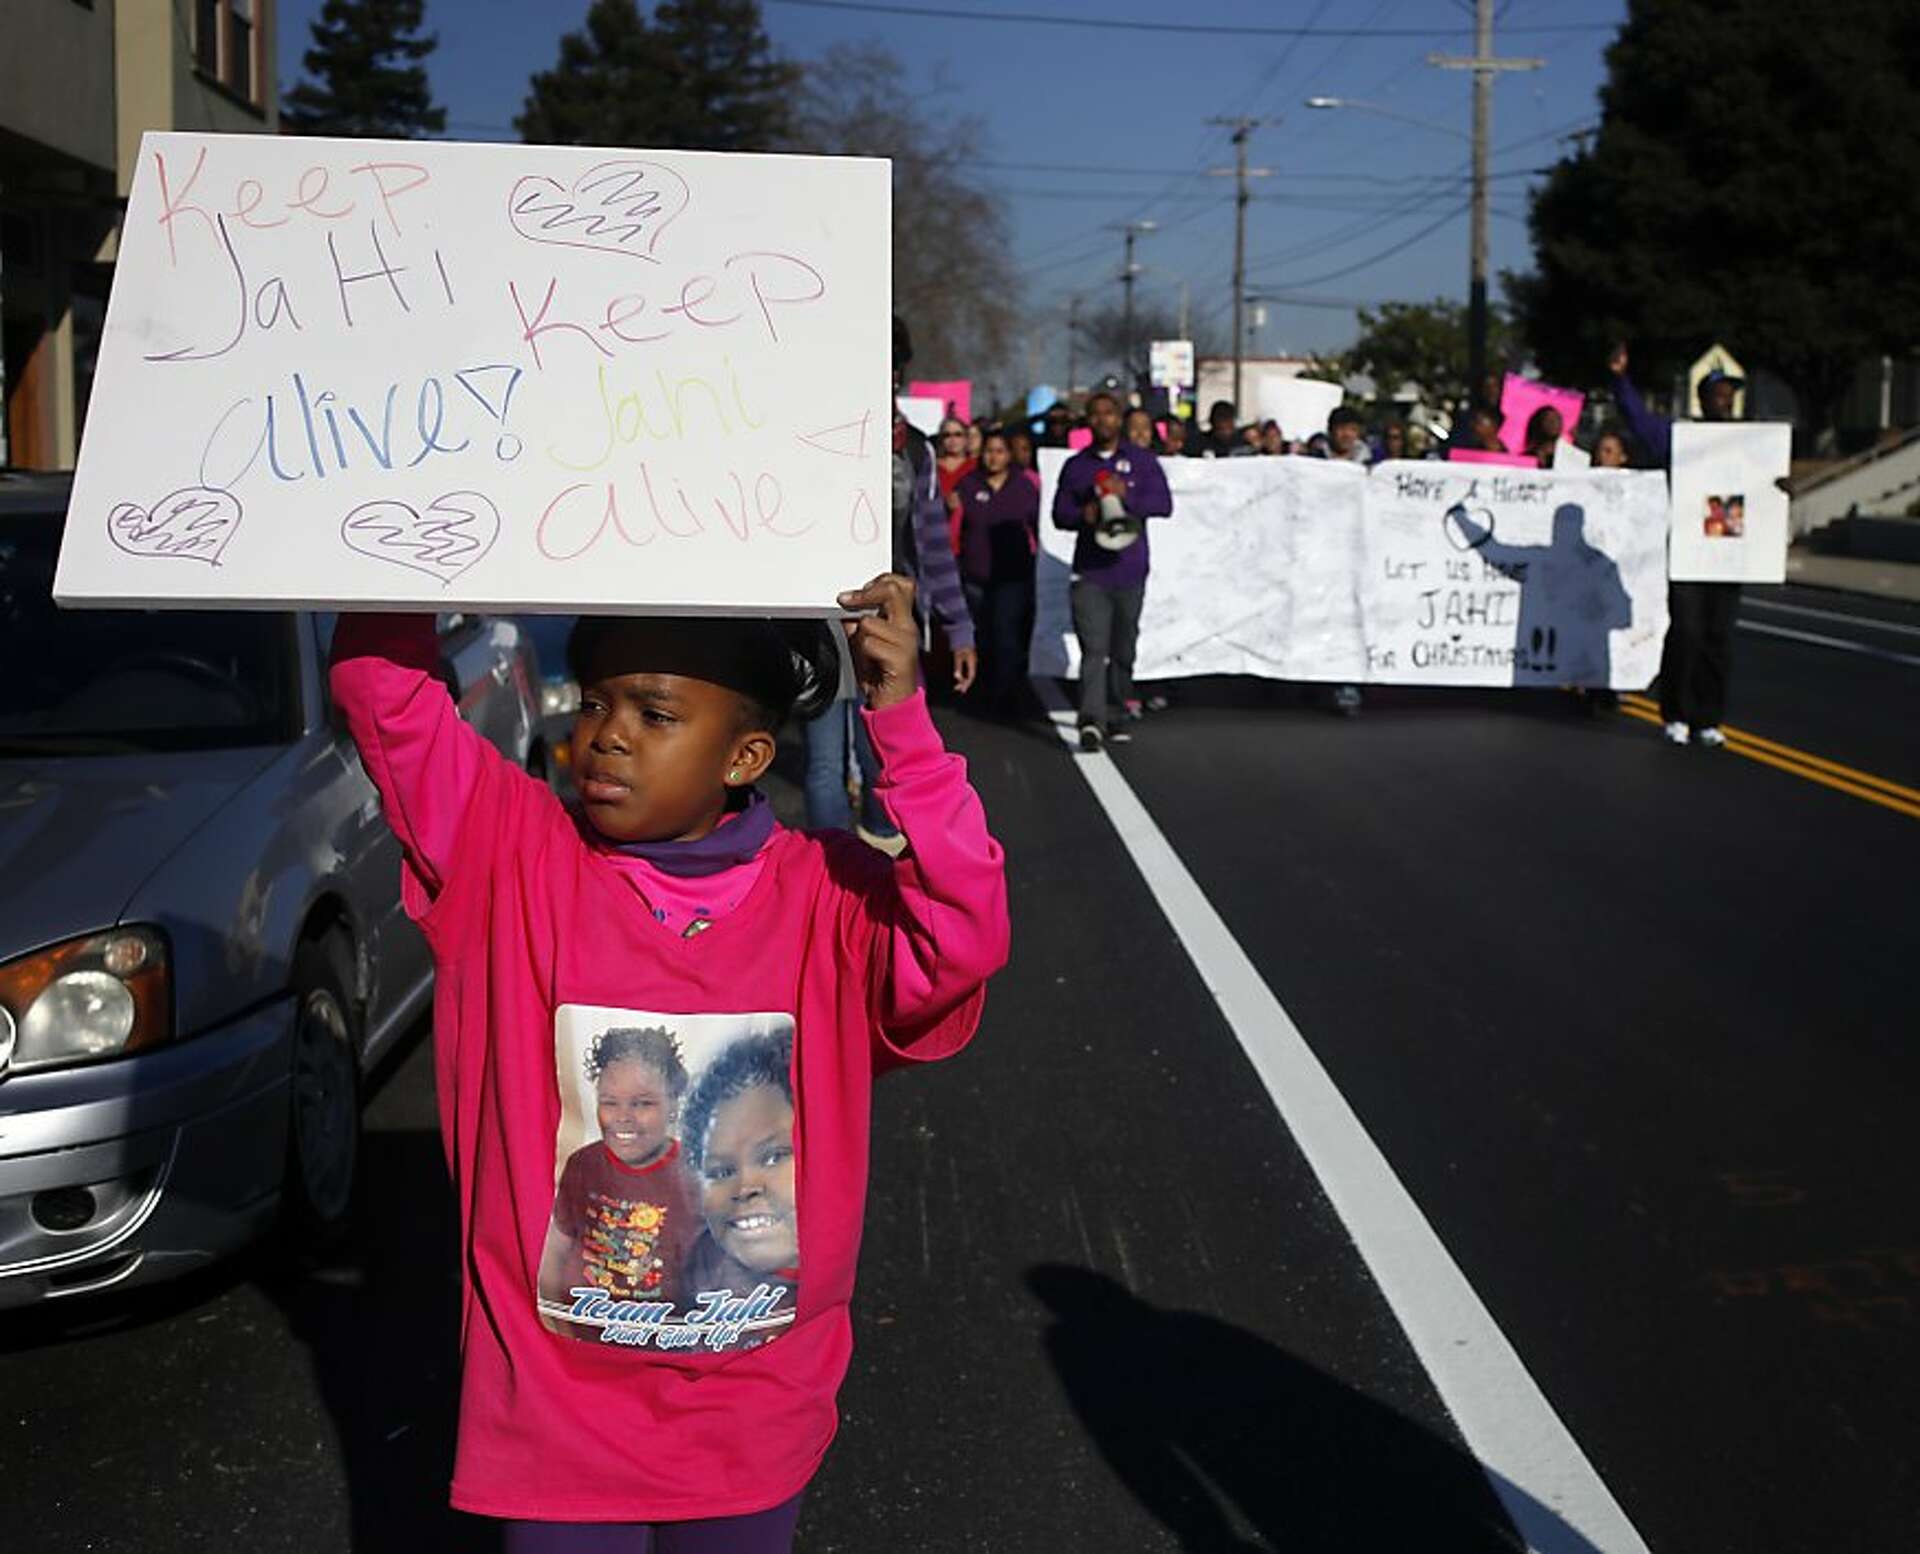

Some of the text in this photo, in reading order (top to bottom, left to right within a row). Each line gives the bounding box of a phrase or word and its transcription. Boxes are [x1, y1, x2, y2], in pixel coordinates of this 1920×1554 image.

[1416, 588, 1516, 629] JAHI
[570, 1283, 787, 1327] Team Jahi
